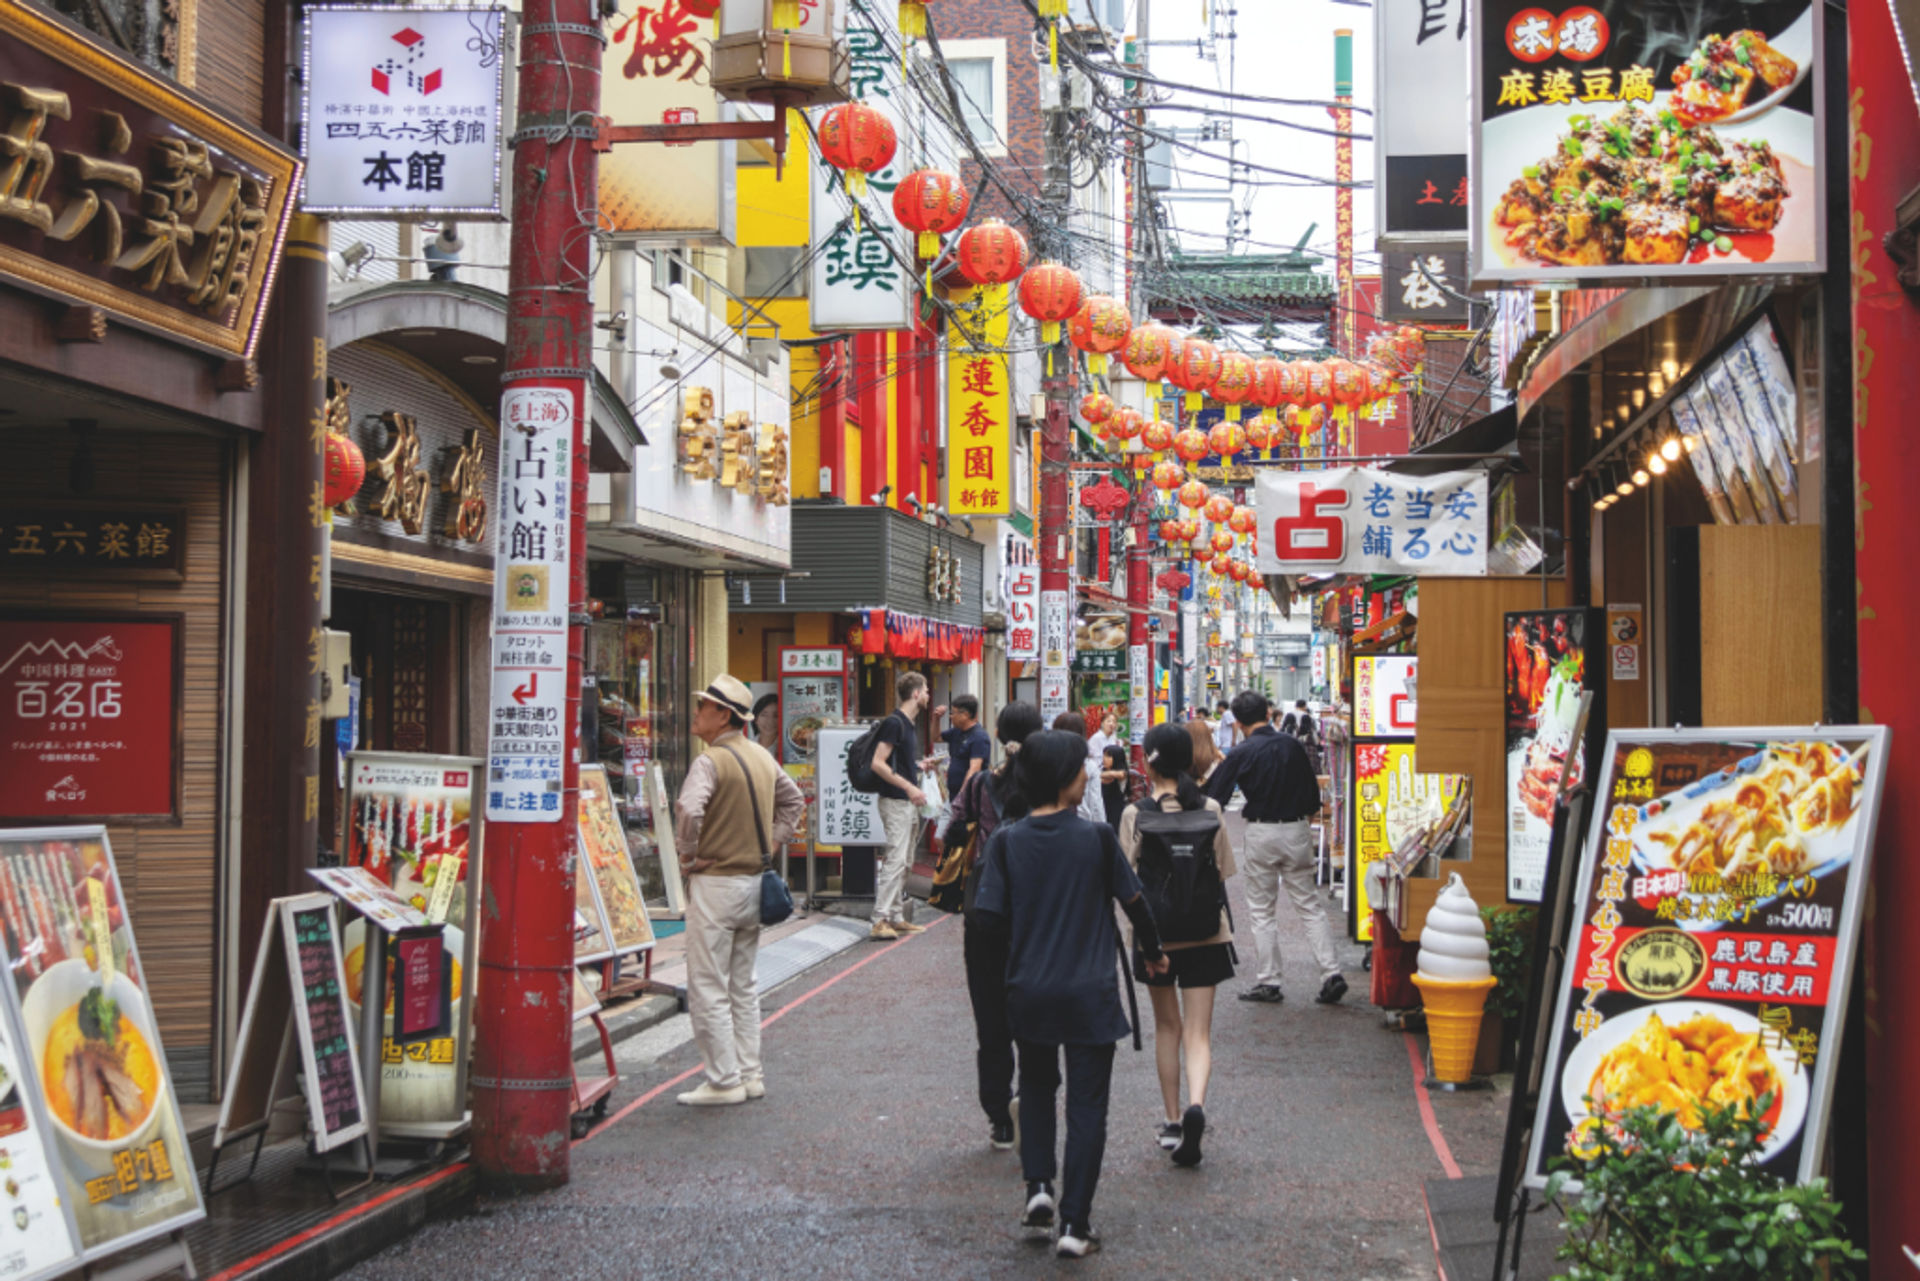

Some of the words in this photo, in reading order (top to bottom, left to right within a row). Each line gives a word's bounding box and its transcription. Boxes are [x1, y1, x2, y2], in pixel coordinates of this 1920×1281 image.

[1513, 14, 1599, 55] 本場
[1497, 64, 1656, 106] 麻婆豆腐
[326, 119, 486, 145] 四五六菜館
[363, 150, 445, 192] 本館
[826, 27, 899, 292] 景鎮
[960, 357, 999, 481] 蓮香園
[510, 438, 549, 561] 占い館
[959, 487, 999, 508] 新館
[1275, 482, 1347, 561] 占
[1012, 571, 1034, 652] 占い館
[507, 635, 545, 648] タロット
[21, 663, 85, 678] 中国料理
[14, 679, 122, 717] 百名店
[495, 706, 558, 722] 中華街通り
[49, 722, 87, 731] 2021
[489, 791, 558, 811] 車に注意
[1573, 803, 1641, 1039] 特別点心フェア中
[1711, 937, 1819, 968] 鹿児島産
[1707, 968, 1814, 998] 黒豚使用
